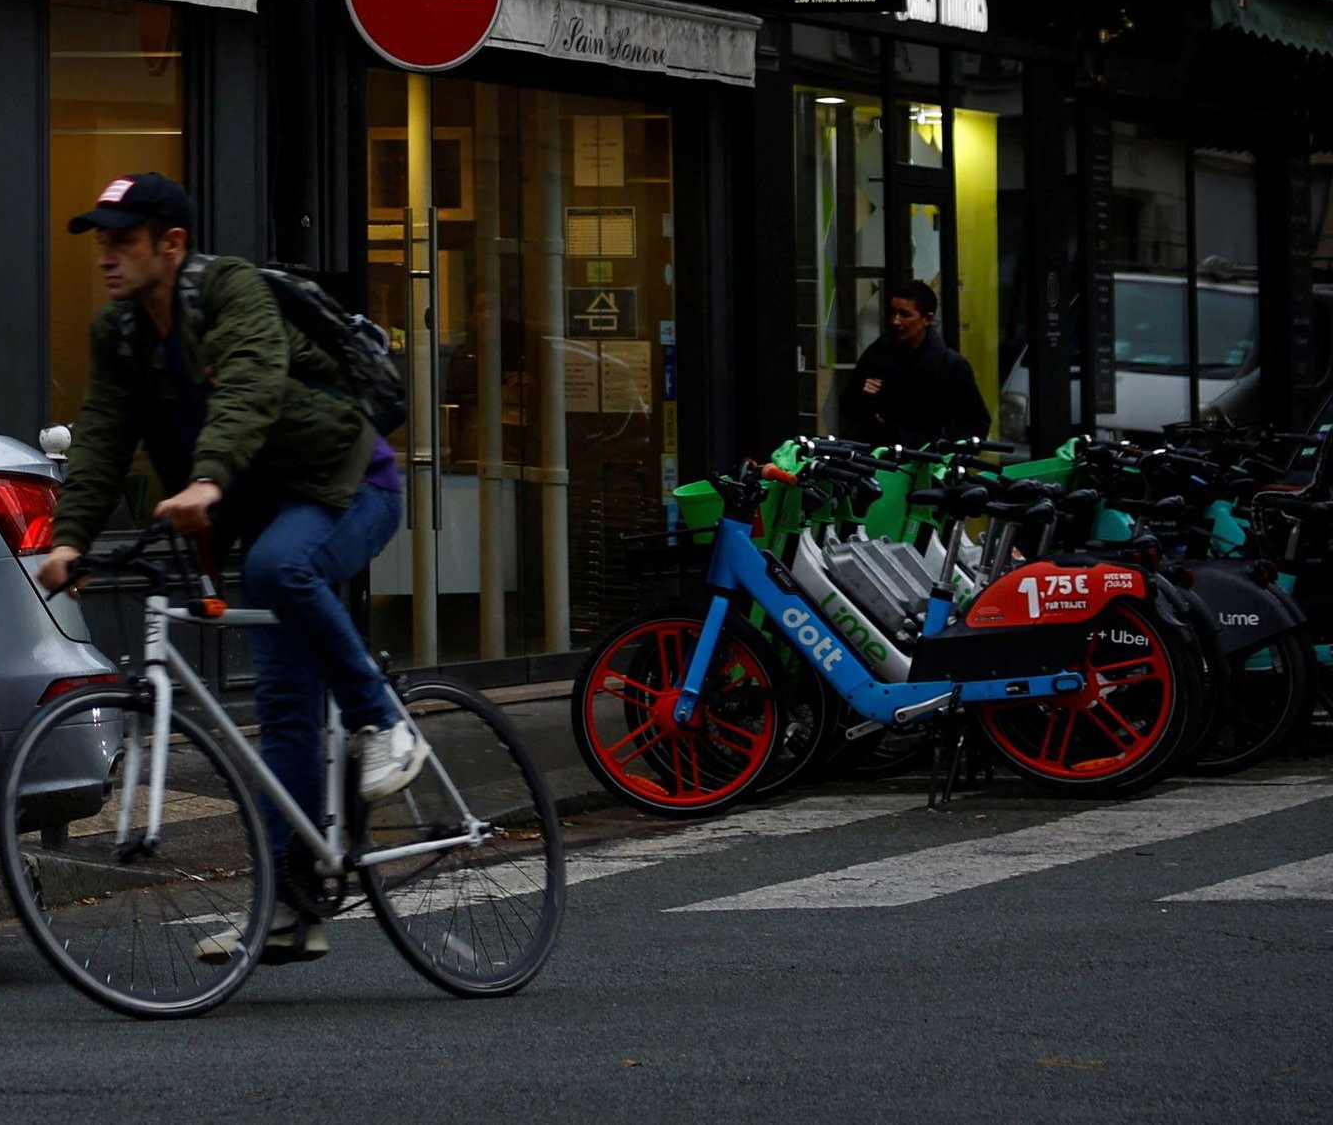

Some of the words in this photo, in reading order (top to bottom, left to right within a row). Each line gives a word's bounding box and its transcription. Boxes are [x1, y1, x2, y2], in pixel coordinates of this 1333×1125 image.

[1104, 579, 1134, 592] pass
[1060, 600, 1087, 610] TRAJET
[1219, 613, 1260, 626] Lime
[782, 607, 845, 672] dott
